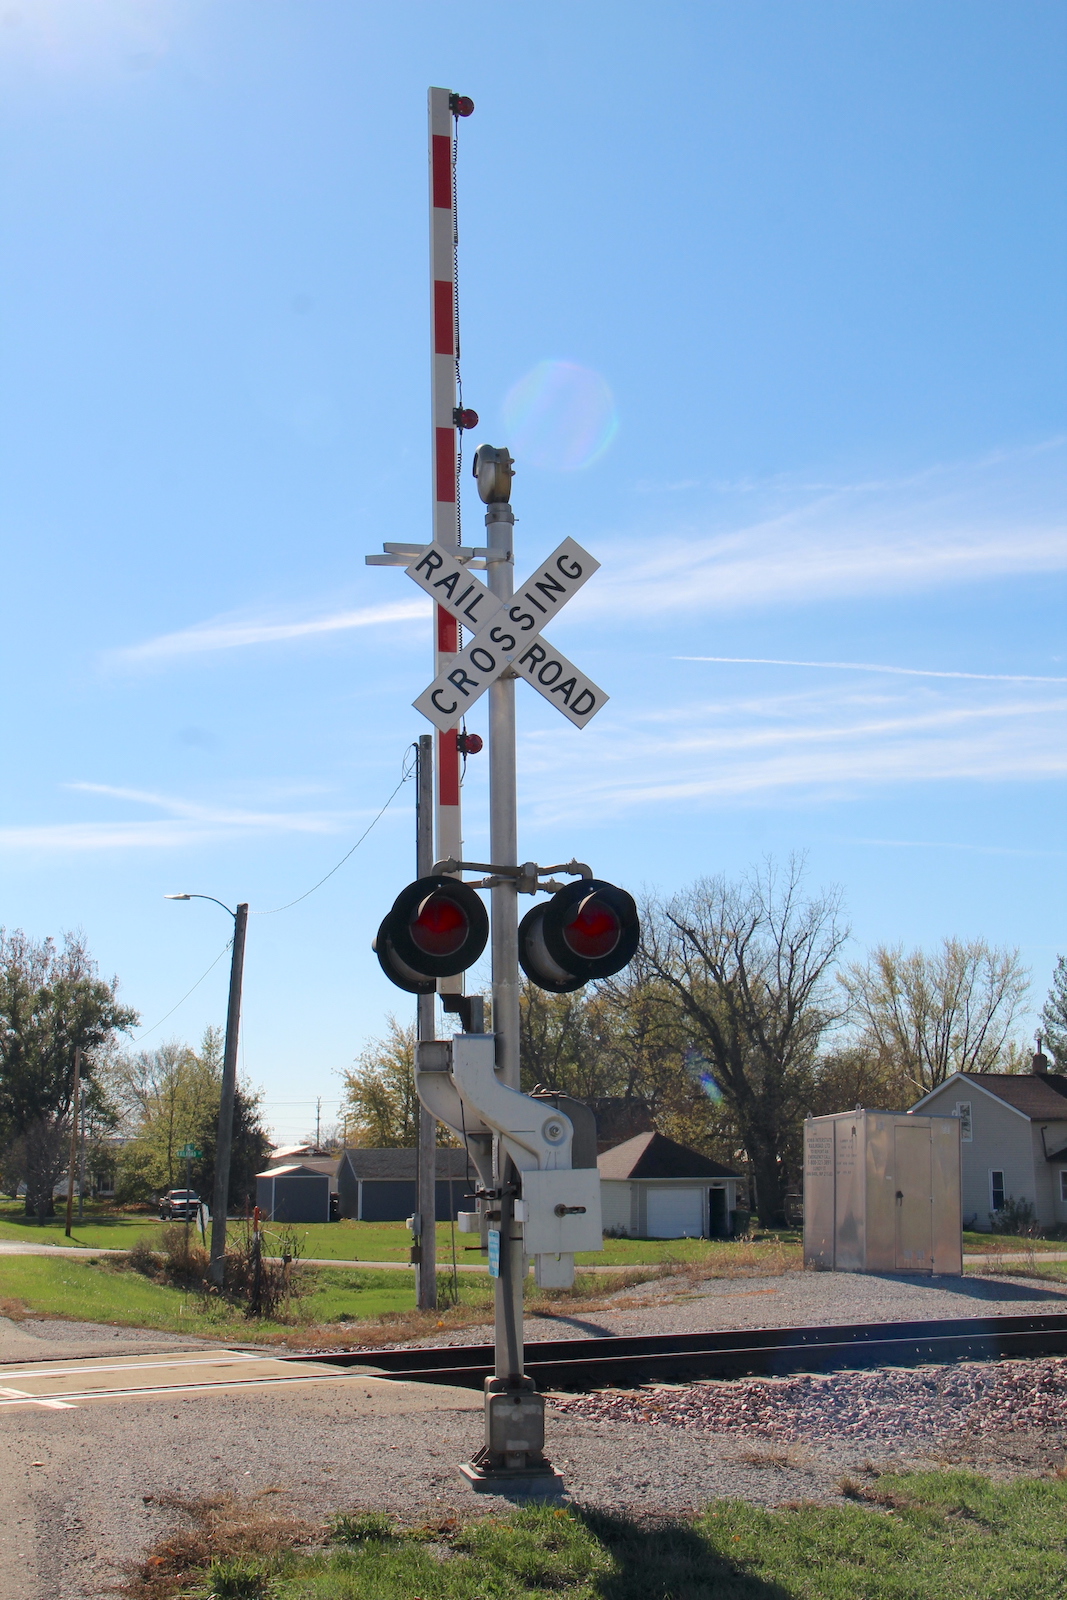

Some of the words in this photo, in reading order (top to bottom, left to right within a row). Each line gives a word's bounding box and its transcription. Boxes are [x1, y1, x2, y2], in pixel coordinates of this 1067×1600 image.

[415, 549, 484, 624] RAIL
[518, 642, 596, 716] ROAD
[430, 554, 583, 715] CROSSING
